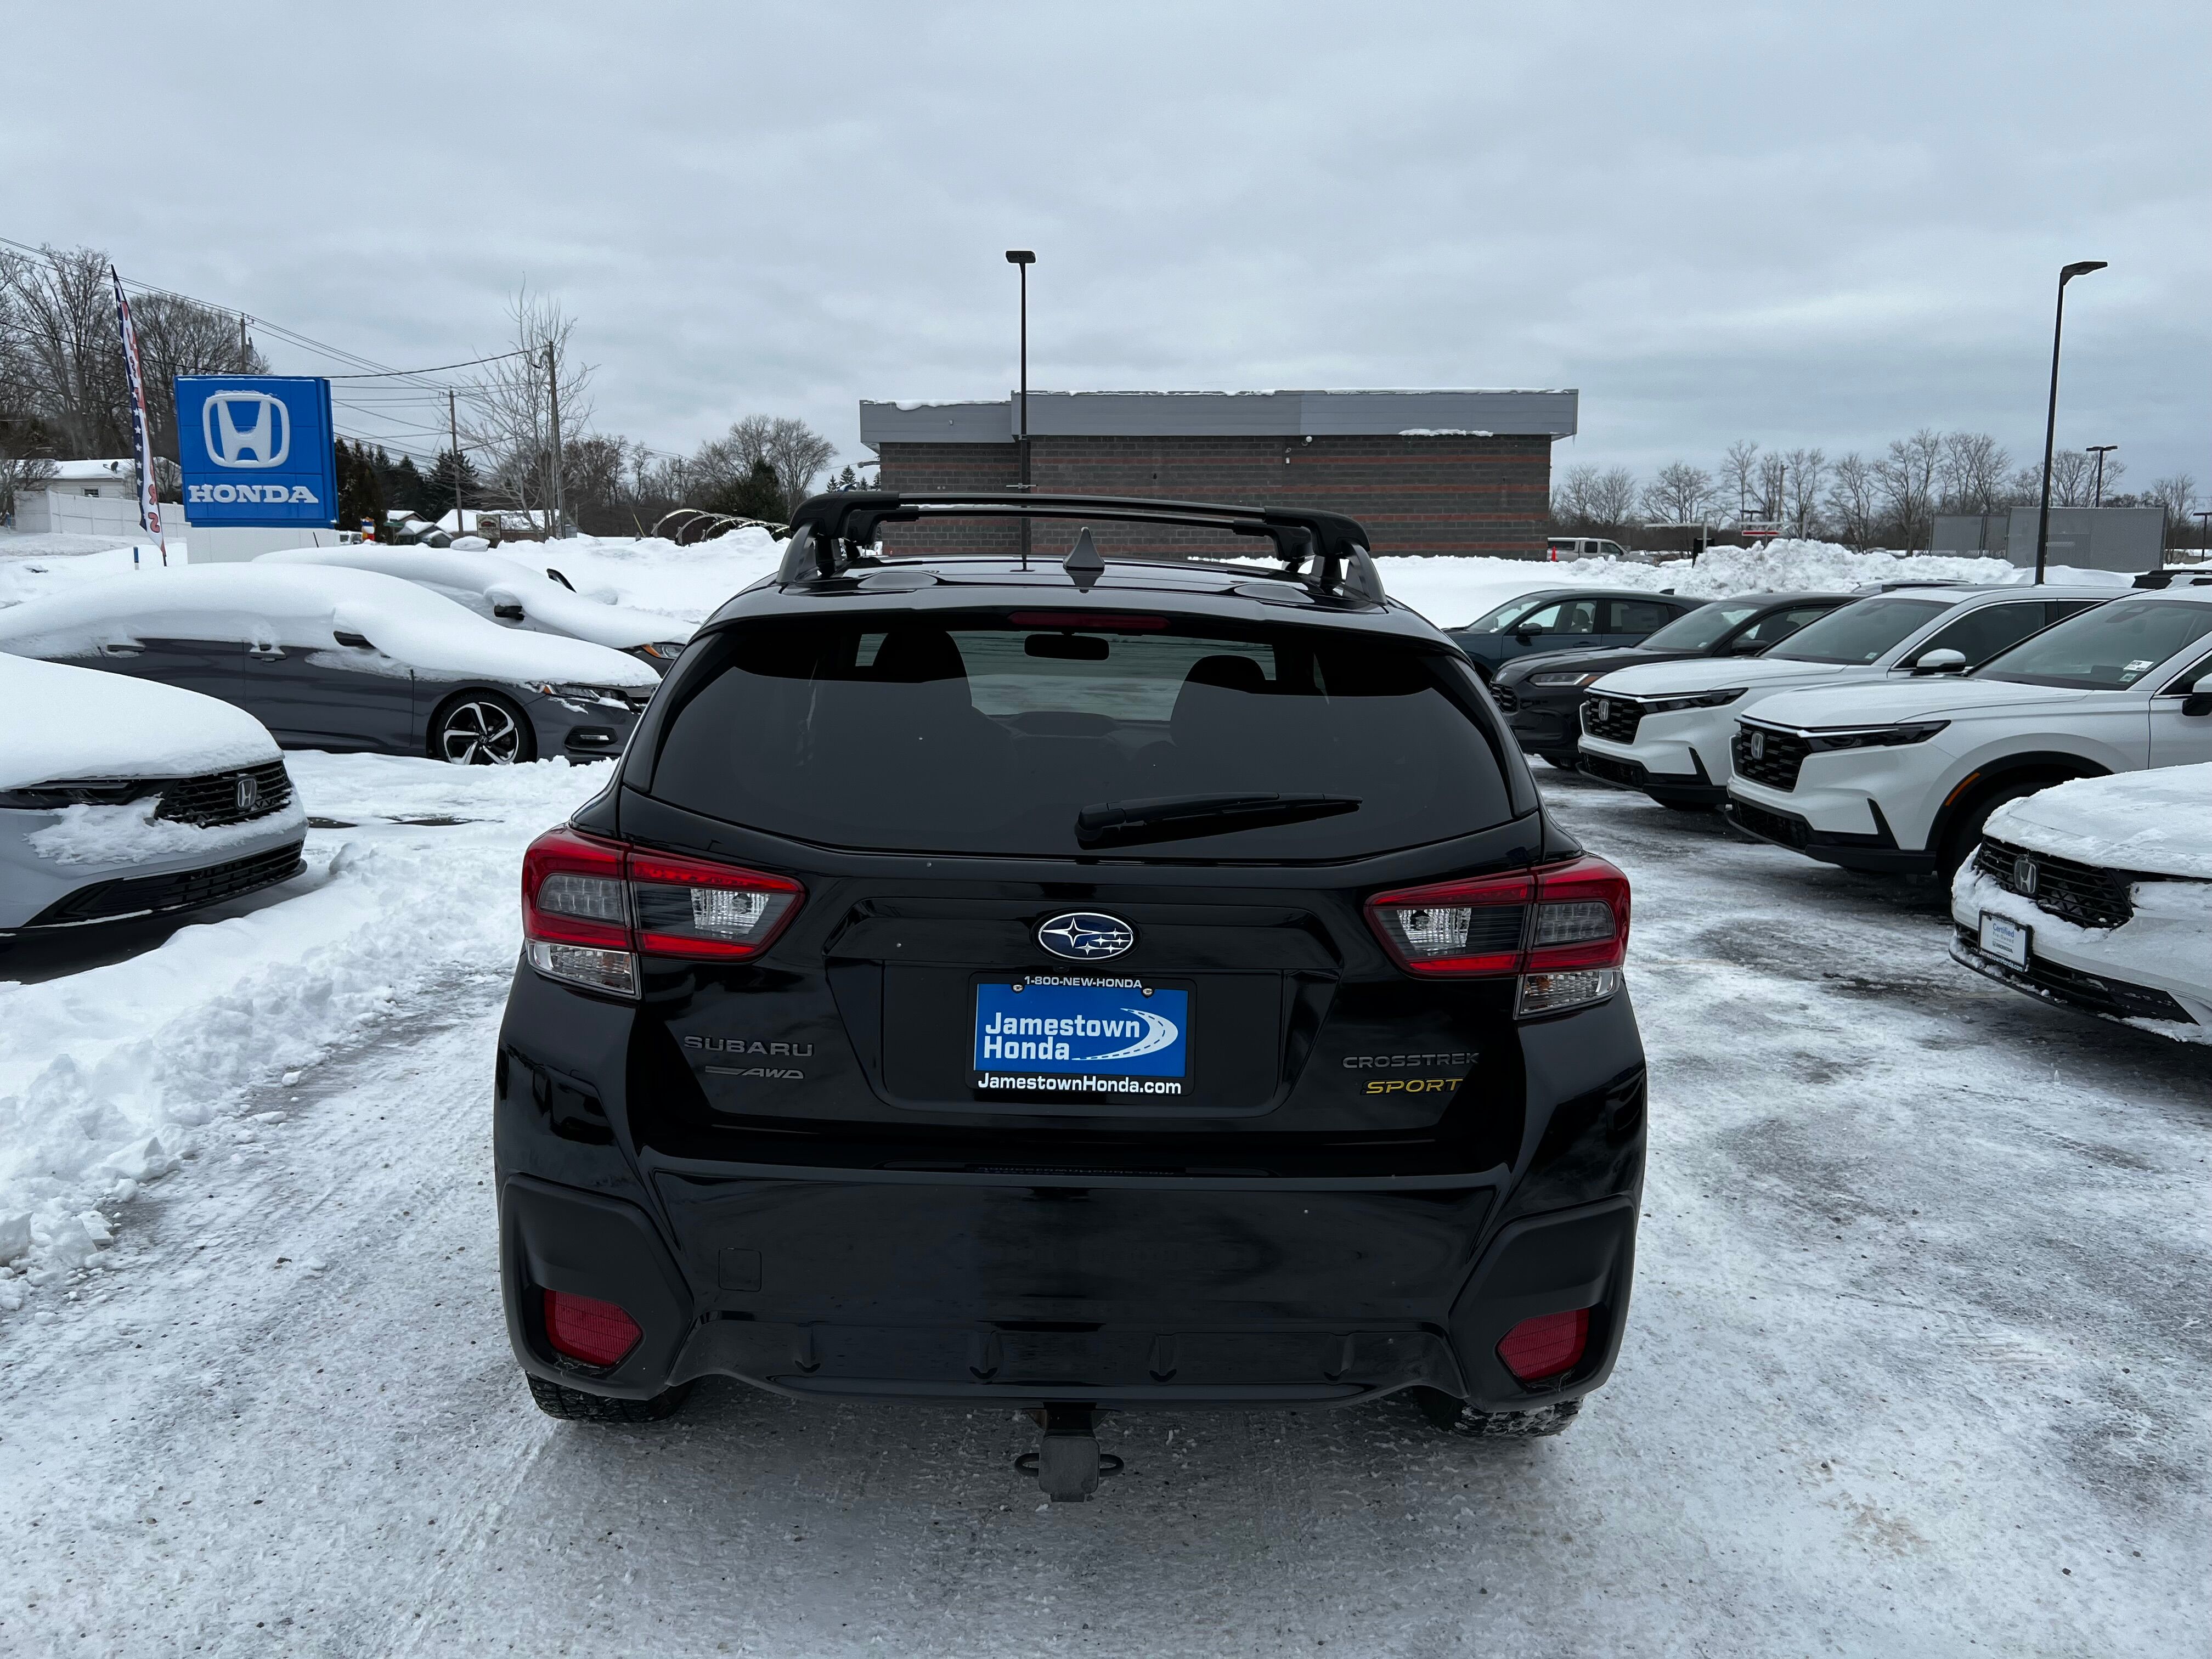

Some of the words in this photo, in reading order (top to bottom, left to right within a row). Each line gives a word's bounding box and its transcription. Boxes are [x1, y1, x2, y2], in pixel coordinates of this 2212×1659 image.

[188, 484, 319, 503] HONDA
[1993, 923, 2015, 938] Certified
[1996, 943, 2013, 953] HONDA
[1024, 976, 1142, 989] 1-800-NEW-HONDA
[985, 1012, 1140, 1038] Jamestown
[684, 1036, 813, 1057] SUBARU
[984, 1035, 1069, 1061] Honda
[1342, 1052, 1480, 1069] CROSSTREK
[742, 1067, 804, 1080] AWD
[978, 1073, 1182, 1094] JamestownHonda.com
[1365, 1079, 1464, 1094] SPORT
